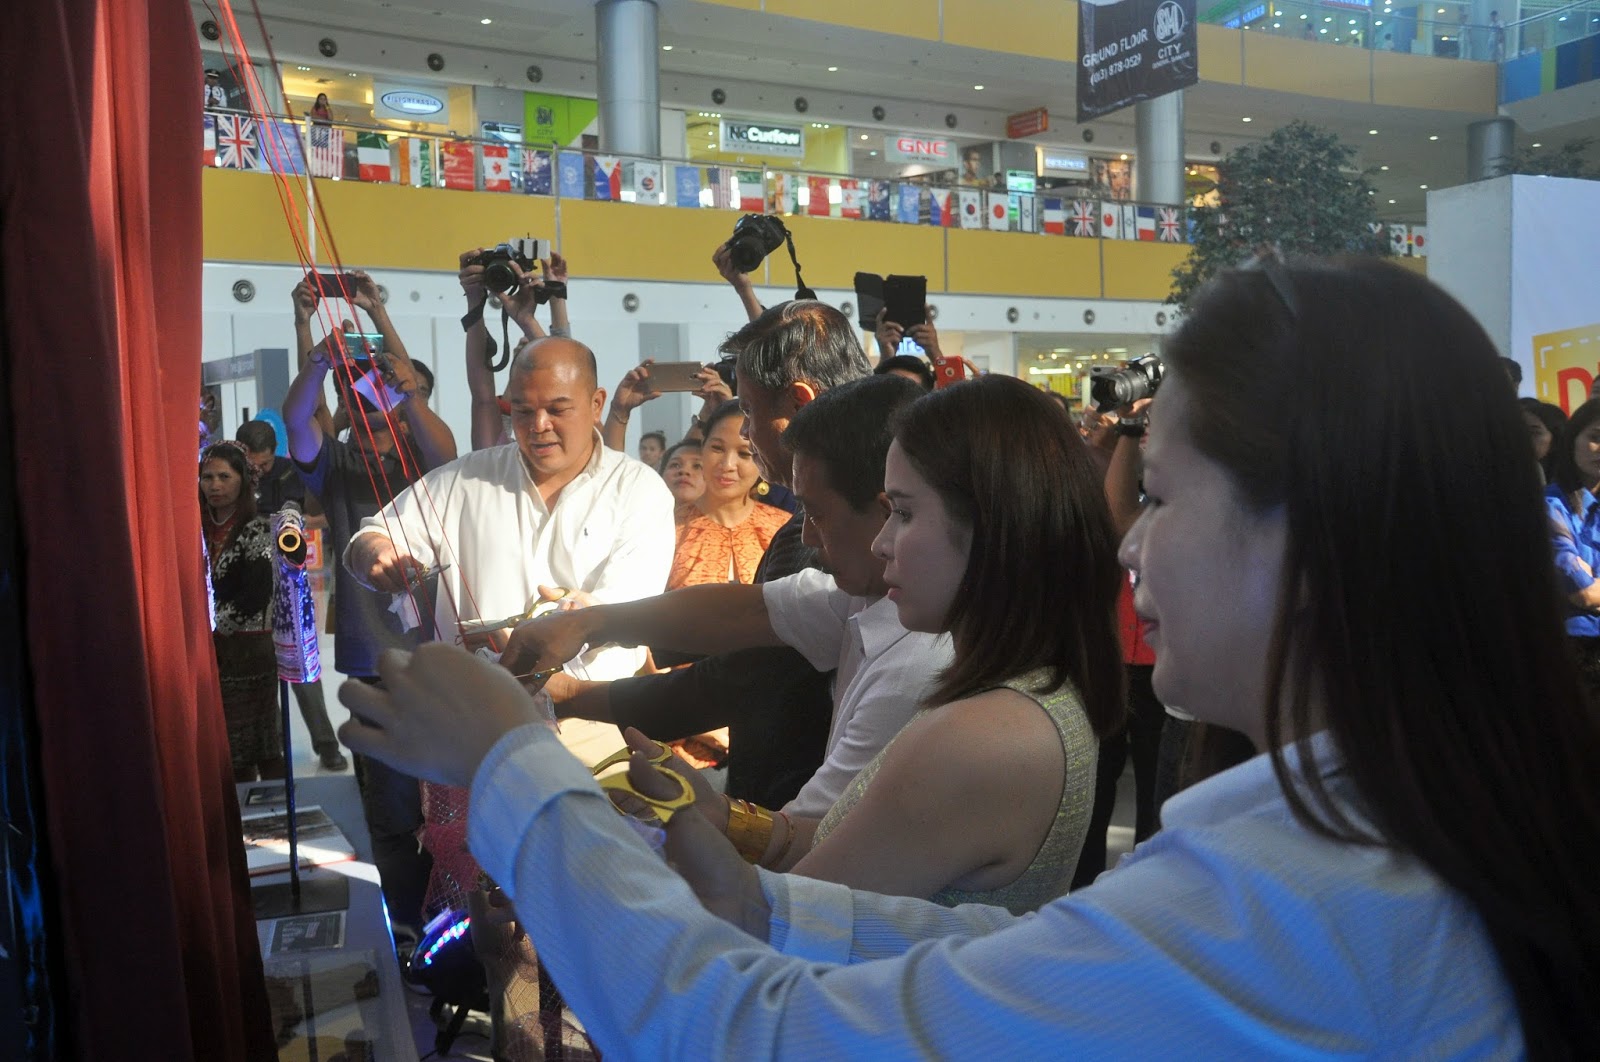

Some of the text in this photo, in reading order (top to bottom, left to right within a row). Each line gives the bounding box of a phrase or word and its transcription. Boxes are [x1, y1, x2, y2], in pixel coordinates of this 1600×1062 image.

[1156, 5, 1180, 40] SM
[1158, 43, 1182, 59] CITY
[896, 137, 949, 158] GNC
